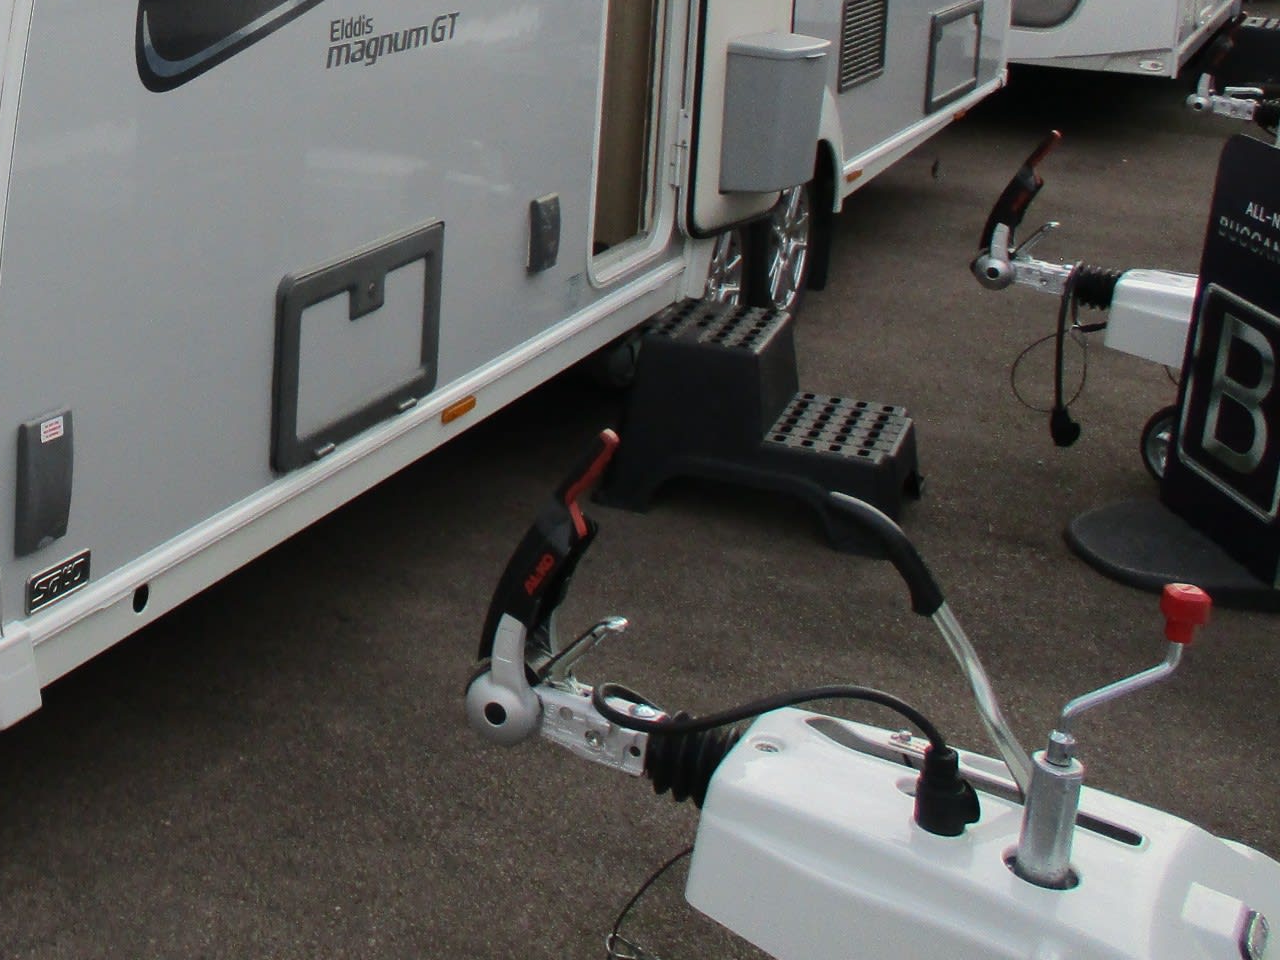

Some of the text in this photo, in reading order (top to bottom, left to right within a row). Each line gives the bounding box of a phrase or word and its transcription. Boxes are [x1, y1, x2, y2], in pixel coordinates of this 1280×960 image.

[326, 11, 460, 69] magnum GT
[329, 14, 373, 43] Elddis
[1201, 312, 1275, 474] B
